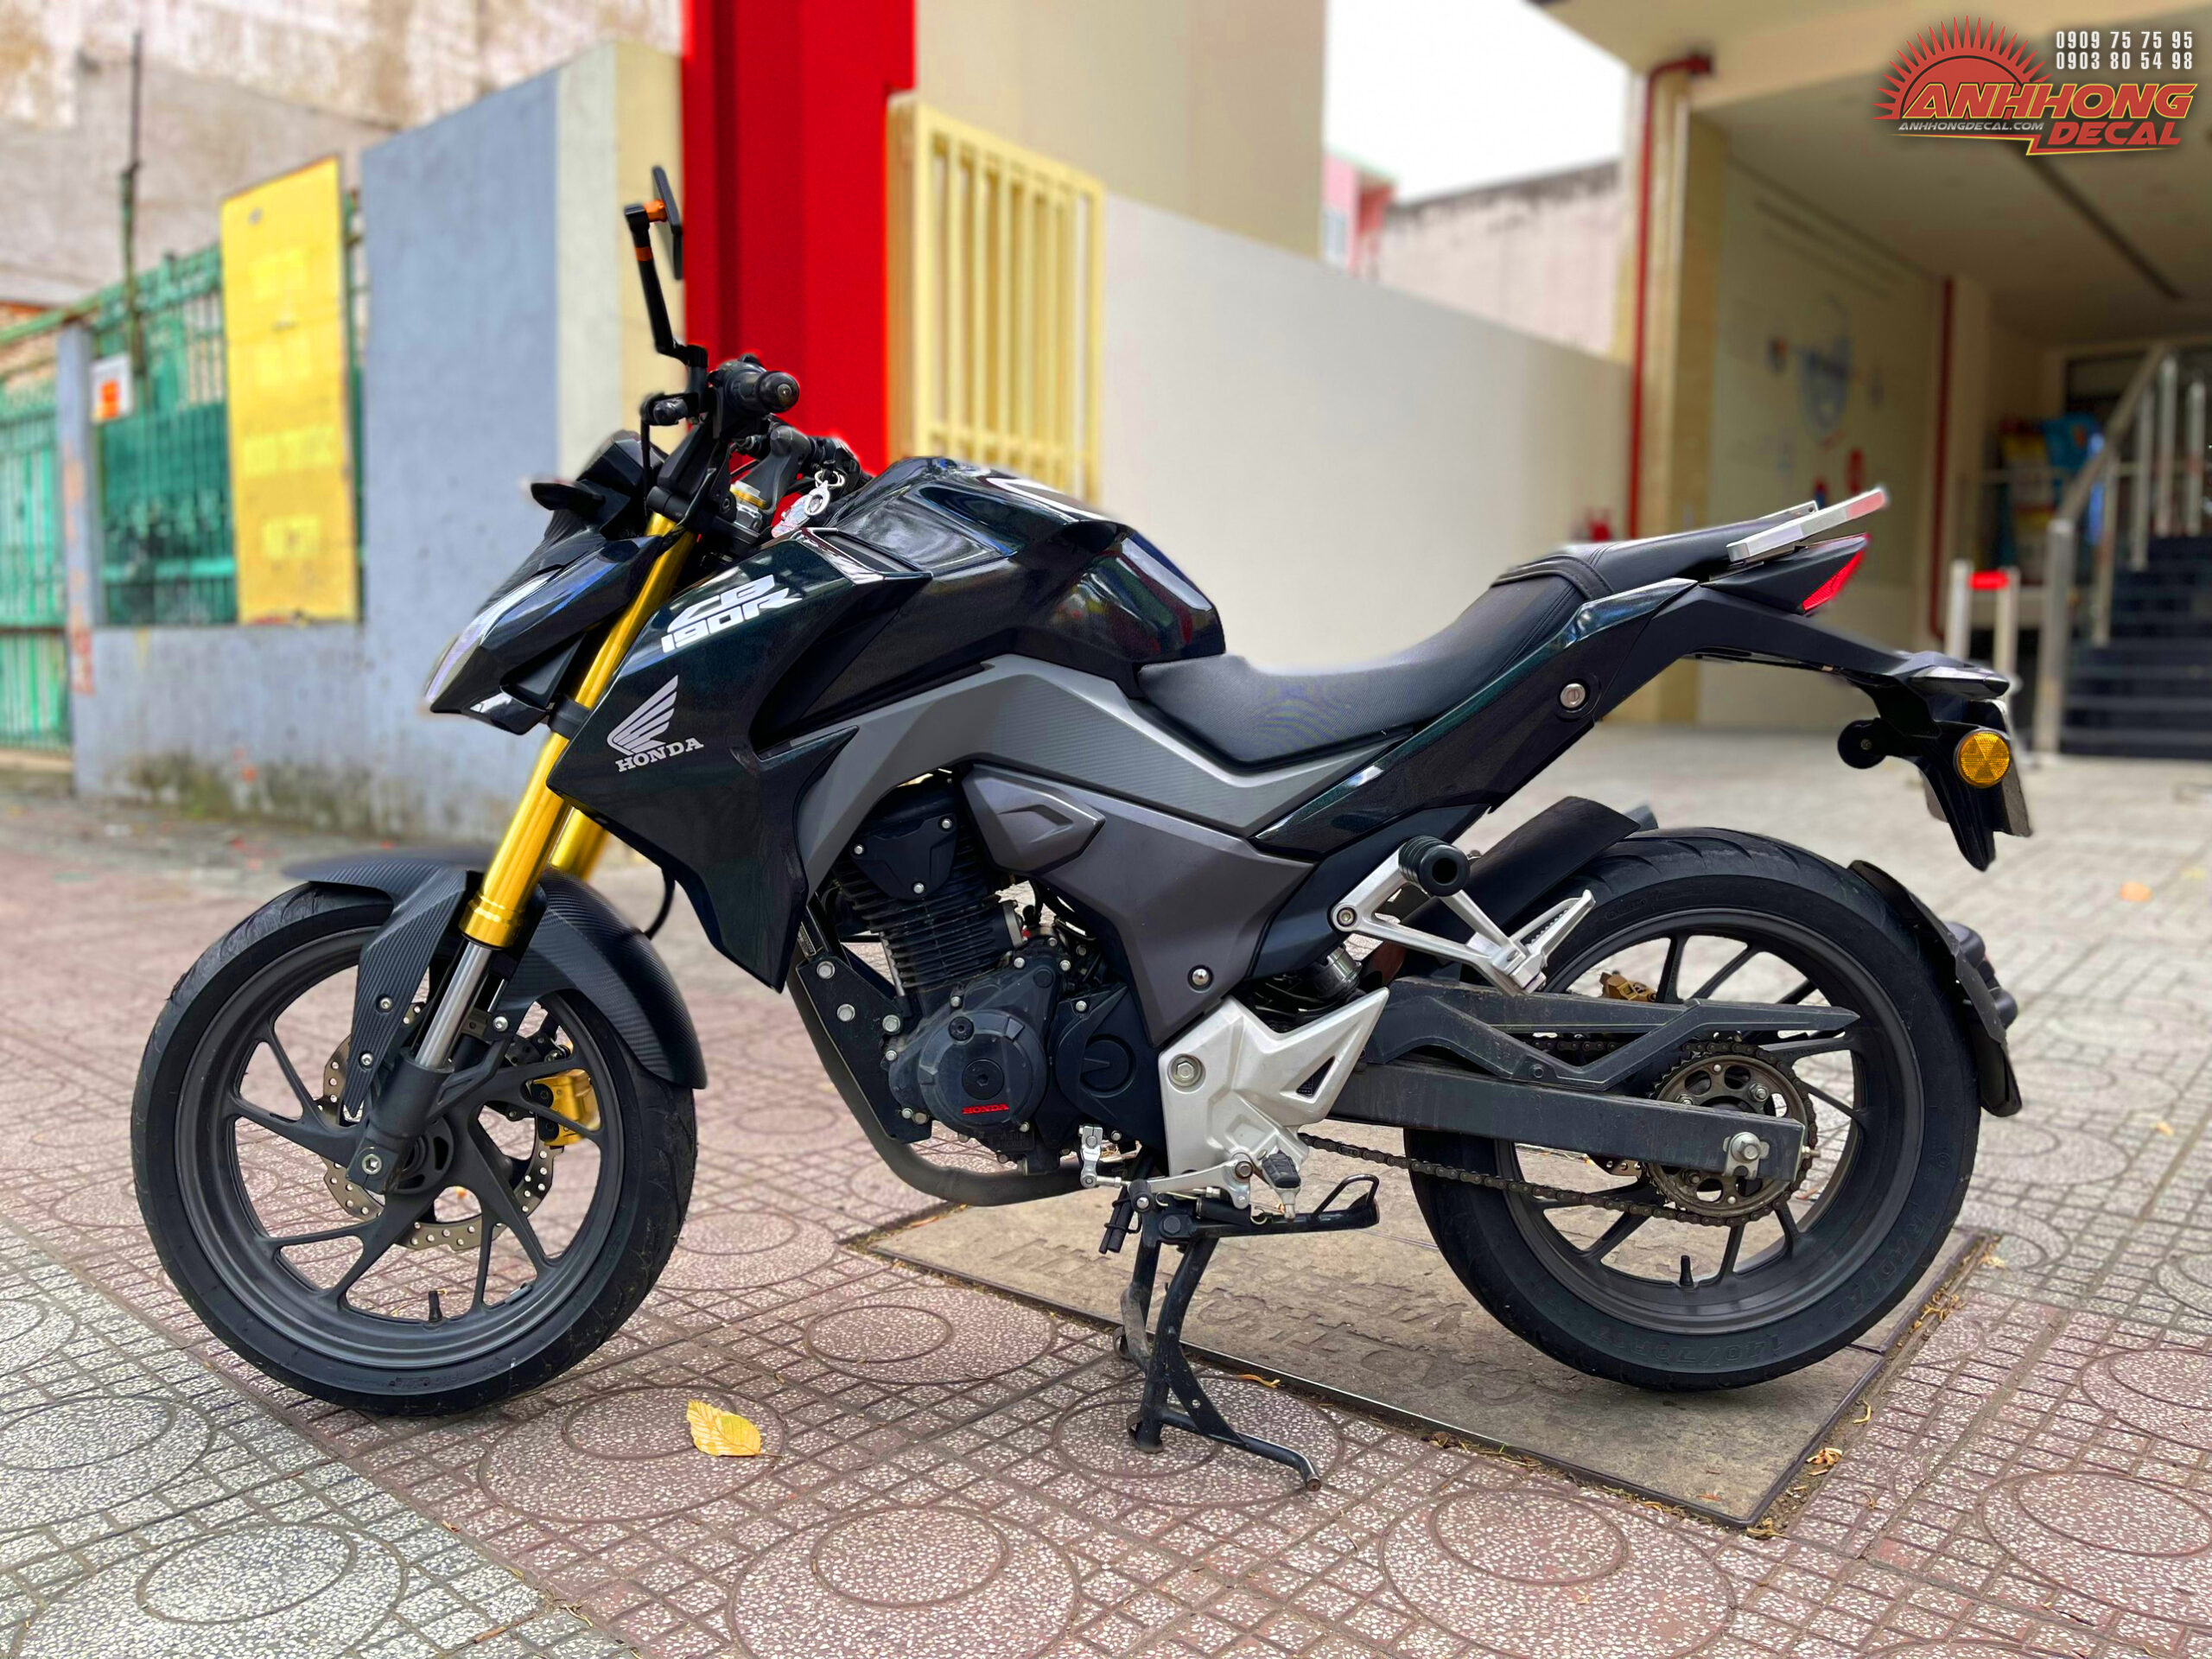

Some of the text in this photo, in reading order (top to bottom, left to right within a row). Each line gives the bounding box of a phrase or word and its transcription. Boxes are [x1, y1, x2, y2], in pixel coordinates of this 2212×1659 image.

[660, 588, 803, 653] 190R
[614, 737, 704, 772] HONDA
[962, 1103, 1009, 1115] HONDA
